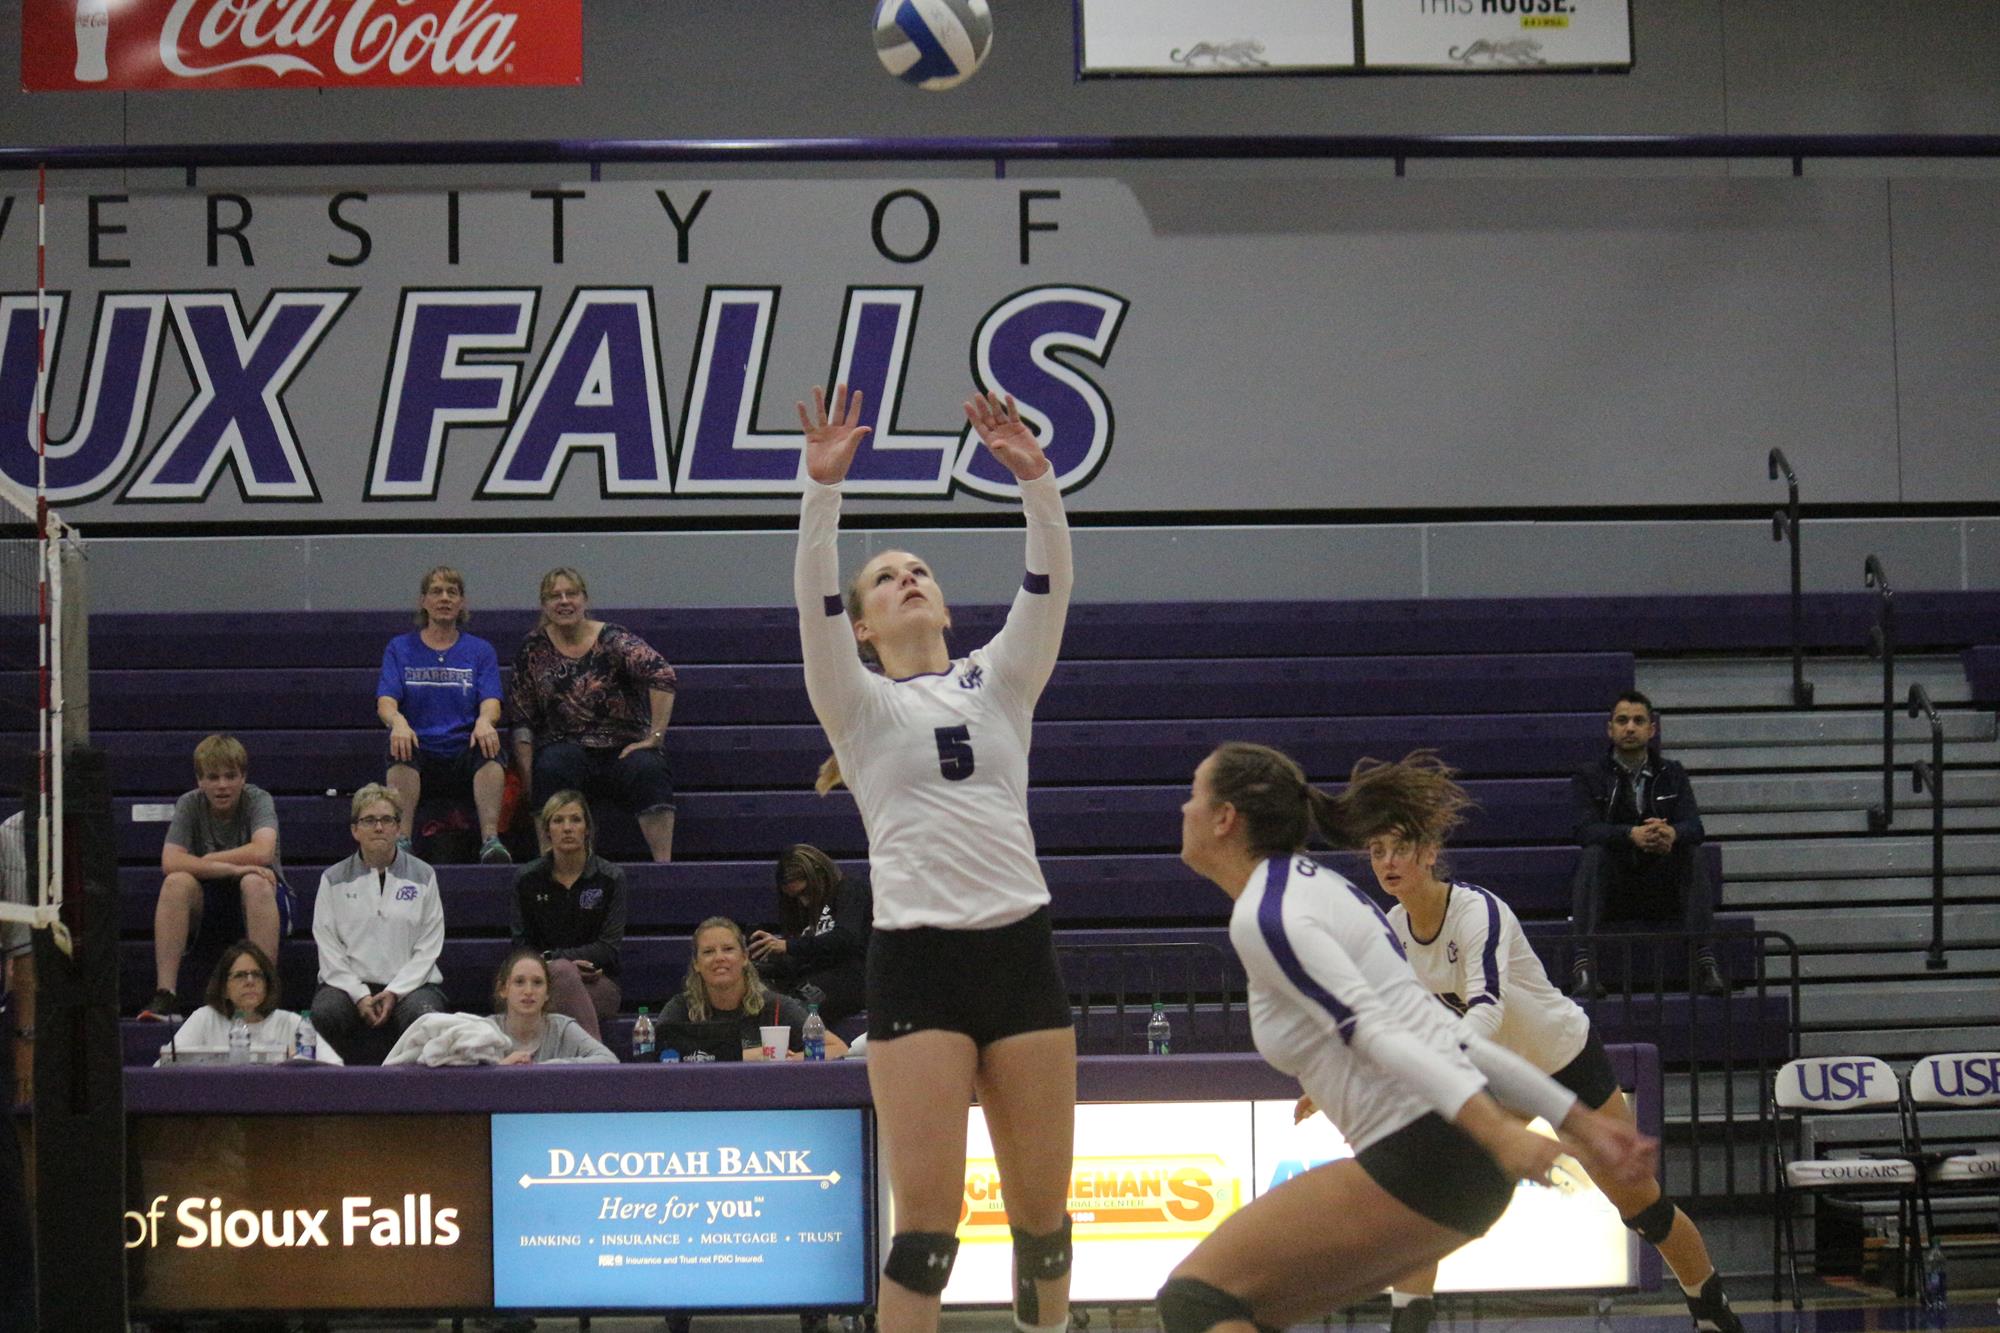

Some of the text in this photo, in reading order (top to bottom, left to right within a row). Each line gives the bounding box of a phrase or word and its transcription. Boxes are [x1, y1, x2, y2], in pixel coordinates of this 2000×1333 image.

[0, 187, 1061, 268] ERSITY OF
[362, 283, 1131, 504] FALLS
[934, 724, 975, 781] 5
[1795, 1062, 1876, 1101] USF
[547, 1147, 812, 1177] DACOTAH BANK
[1820, 1165, 1900, 1180] COUGARS
[124, 1193, 461, 1248] of Sioux Falls
[597, 1196, 658, 1220] Here
[658, 1195, 700, 1225] for
[519, 1231, 843, 1247] BANKING INSURANCE MORTGAGE TRUST
[625, 1255, 662, 1265] Insurance
[663, 1255, 678, 1264] and
[679, 1255, 698, 1264] Trust
[699, 1255, 712, 1264] not
[713, 1254, 733, 1264] FDIC
